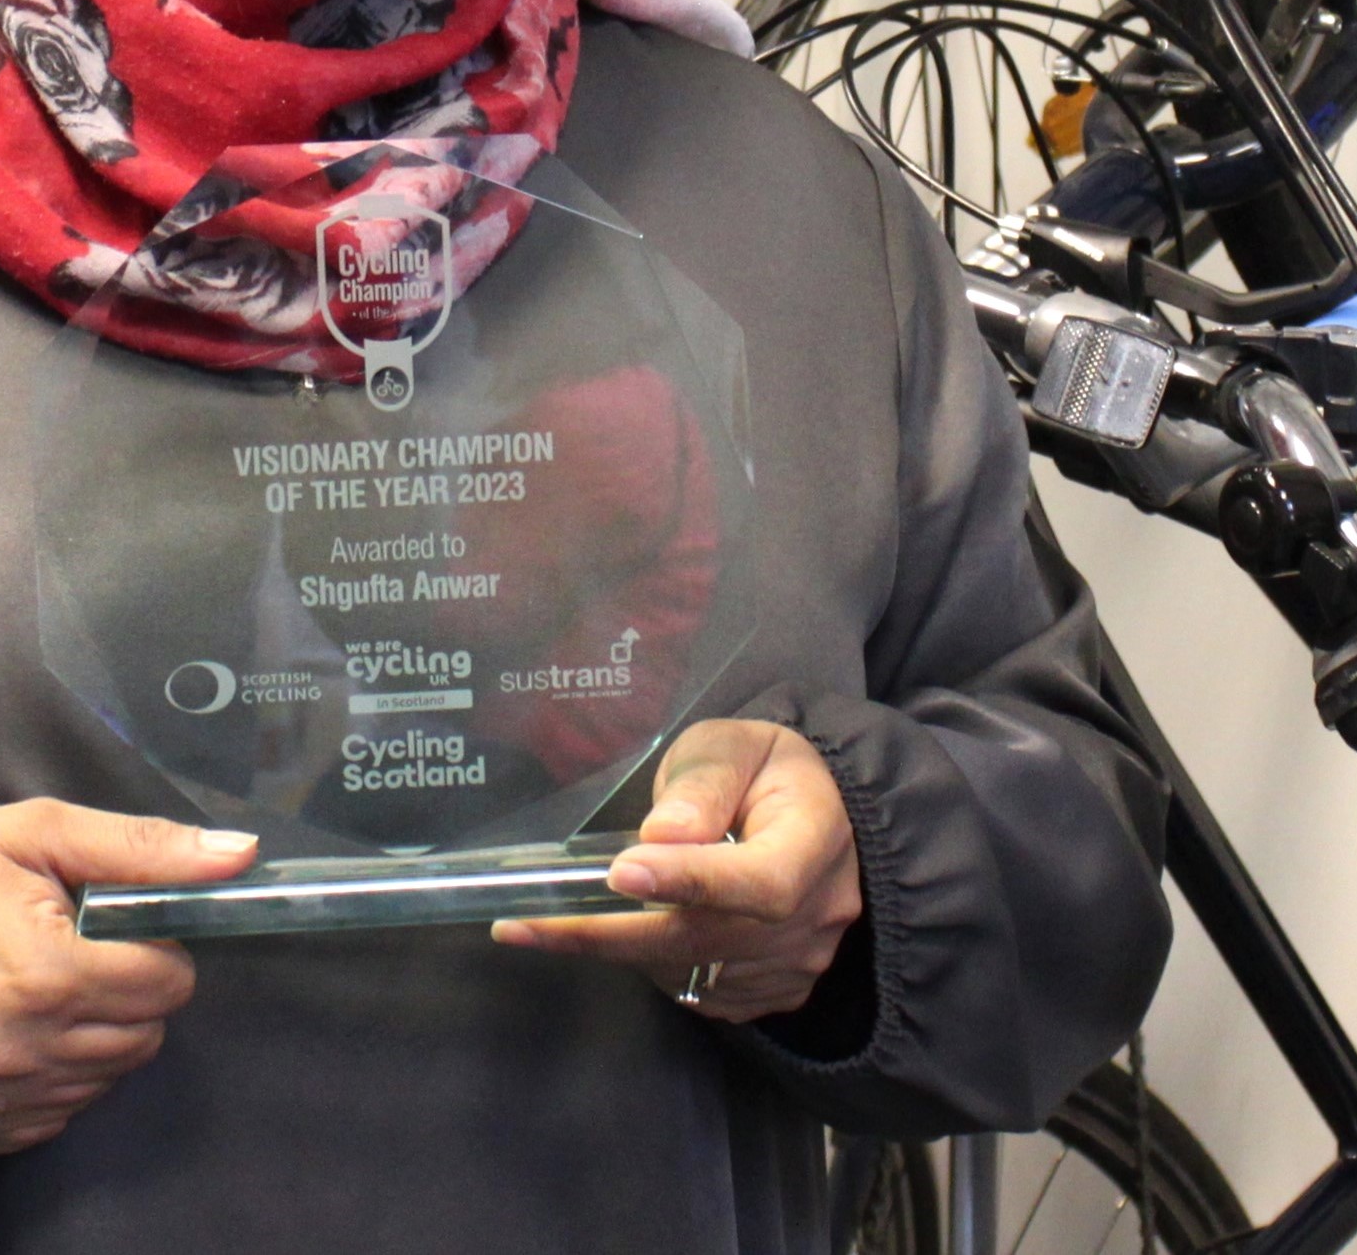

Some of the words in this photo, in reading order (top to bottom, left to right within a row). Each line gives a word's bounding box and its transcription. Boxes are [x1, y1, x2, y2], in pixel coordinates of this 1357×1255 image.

[338, 243, 430, 282] Cycling
[339, 278, 433, 305] Champion
[233, 440, 390, 477] VISIONARY
[398, 432, 555, 469] CHAMPION
[265, 481, 303, 514] OF
[310, 478, 367, 511] THE
[373, 474, 450, 508] YEAR
[456, 471, 527, 504] 2023
[330, 533, 435, 564] Awarded
[441, 535, 466, 558] to
[299, 573, 405, 612] Shgufta
[412, 571, 502, 601] Anwar
[346, 642, 372, 654] we
[375, 640, 403, 653] are
[242, 671, 312, 687] SCOTTISH
[346, 646, 473, 684] cycling
[429, 674, 451, 686] UK
[499, 664, 632, 693] sustrans
[241, 686, 323, 704] CYCLING
[392, 695, 445, 708] Scotland
[341, 729, 465, 768] Cycling
[342, 755, 487, 792] Scotland
